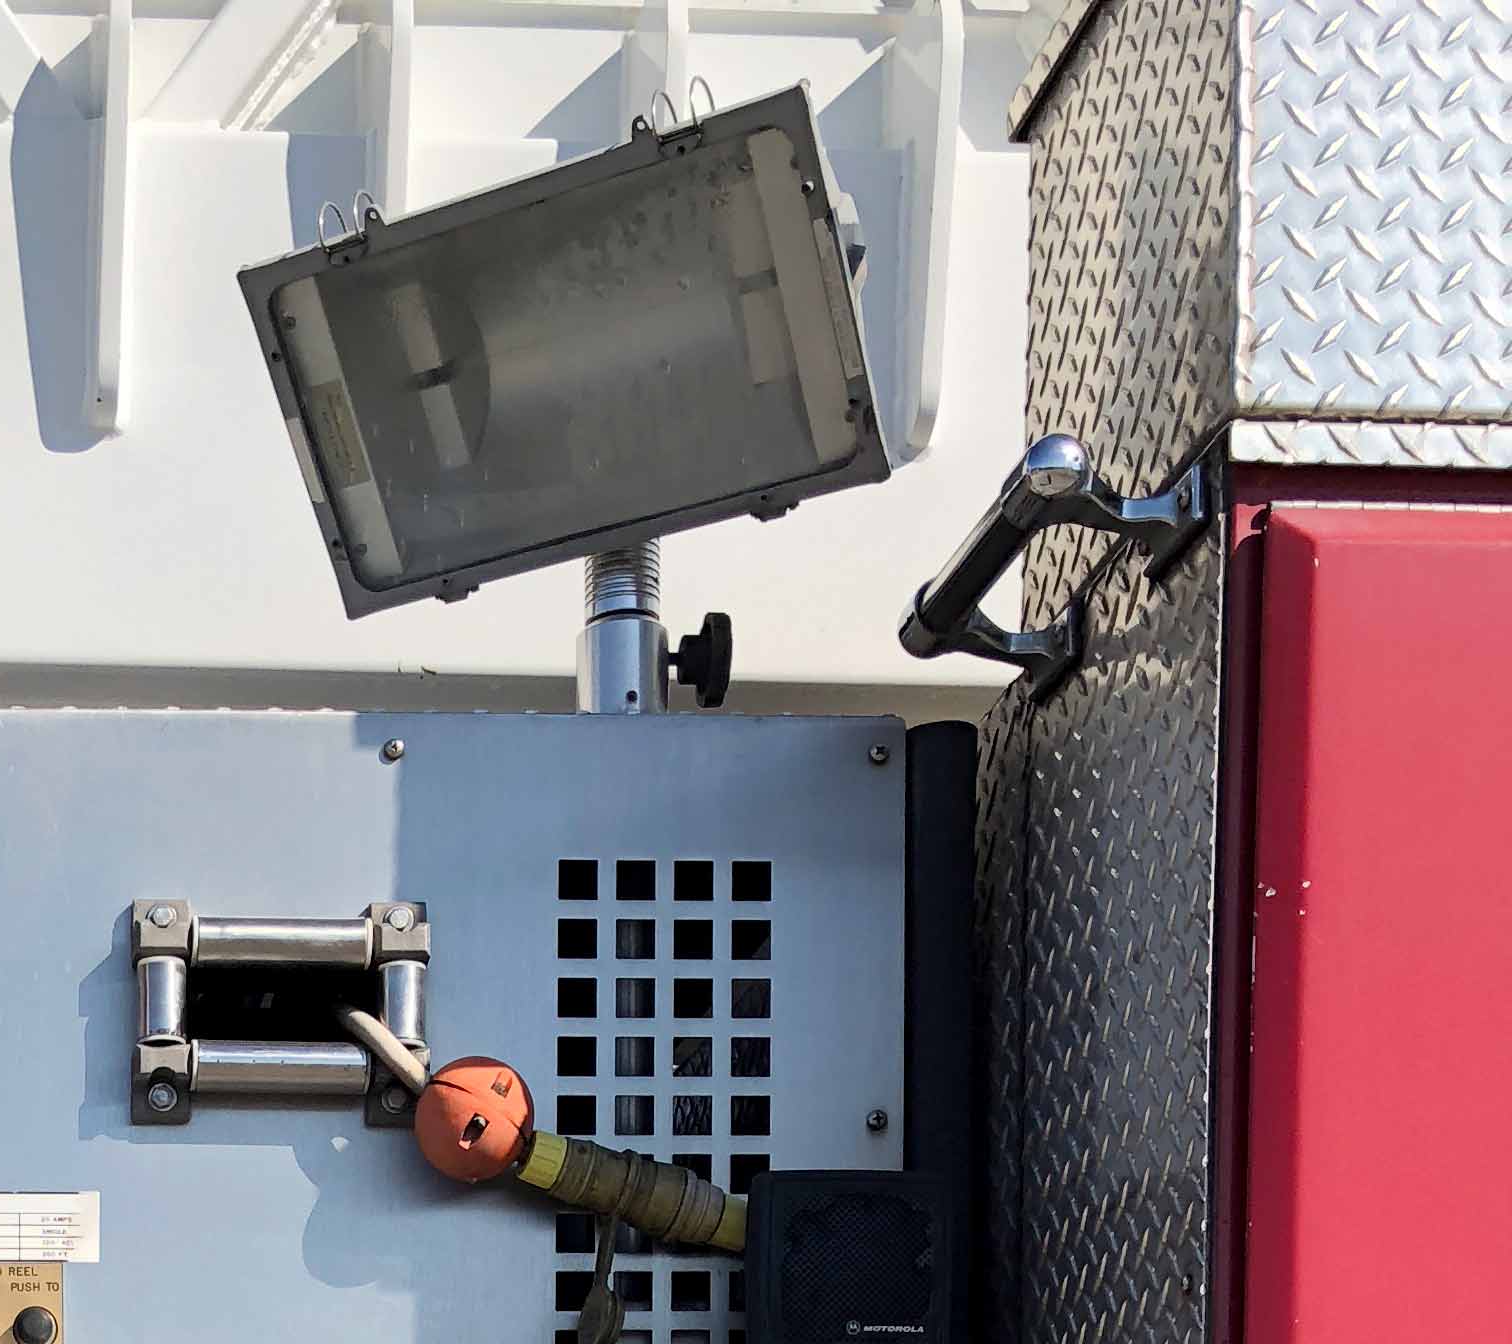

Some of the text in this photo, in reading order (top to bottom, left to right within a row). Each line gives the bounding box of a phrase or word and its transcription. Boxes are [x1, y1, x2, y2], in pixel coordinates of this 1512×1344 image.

[8, 1266, 38, 1277] REEL
[10, 1281, 60, 1292] PUSH TO
[863, 1325, 924, 1333] MOTOROLA
